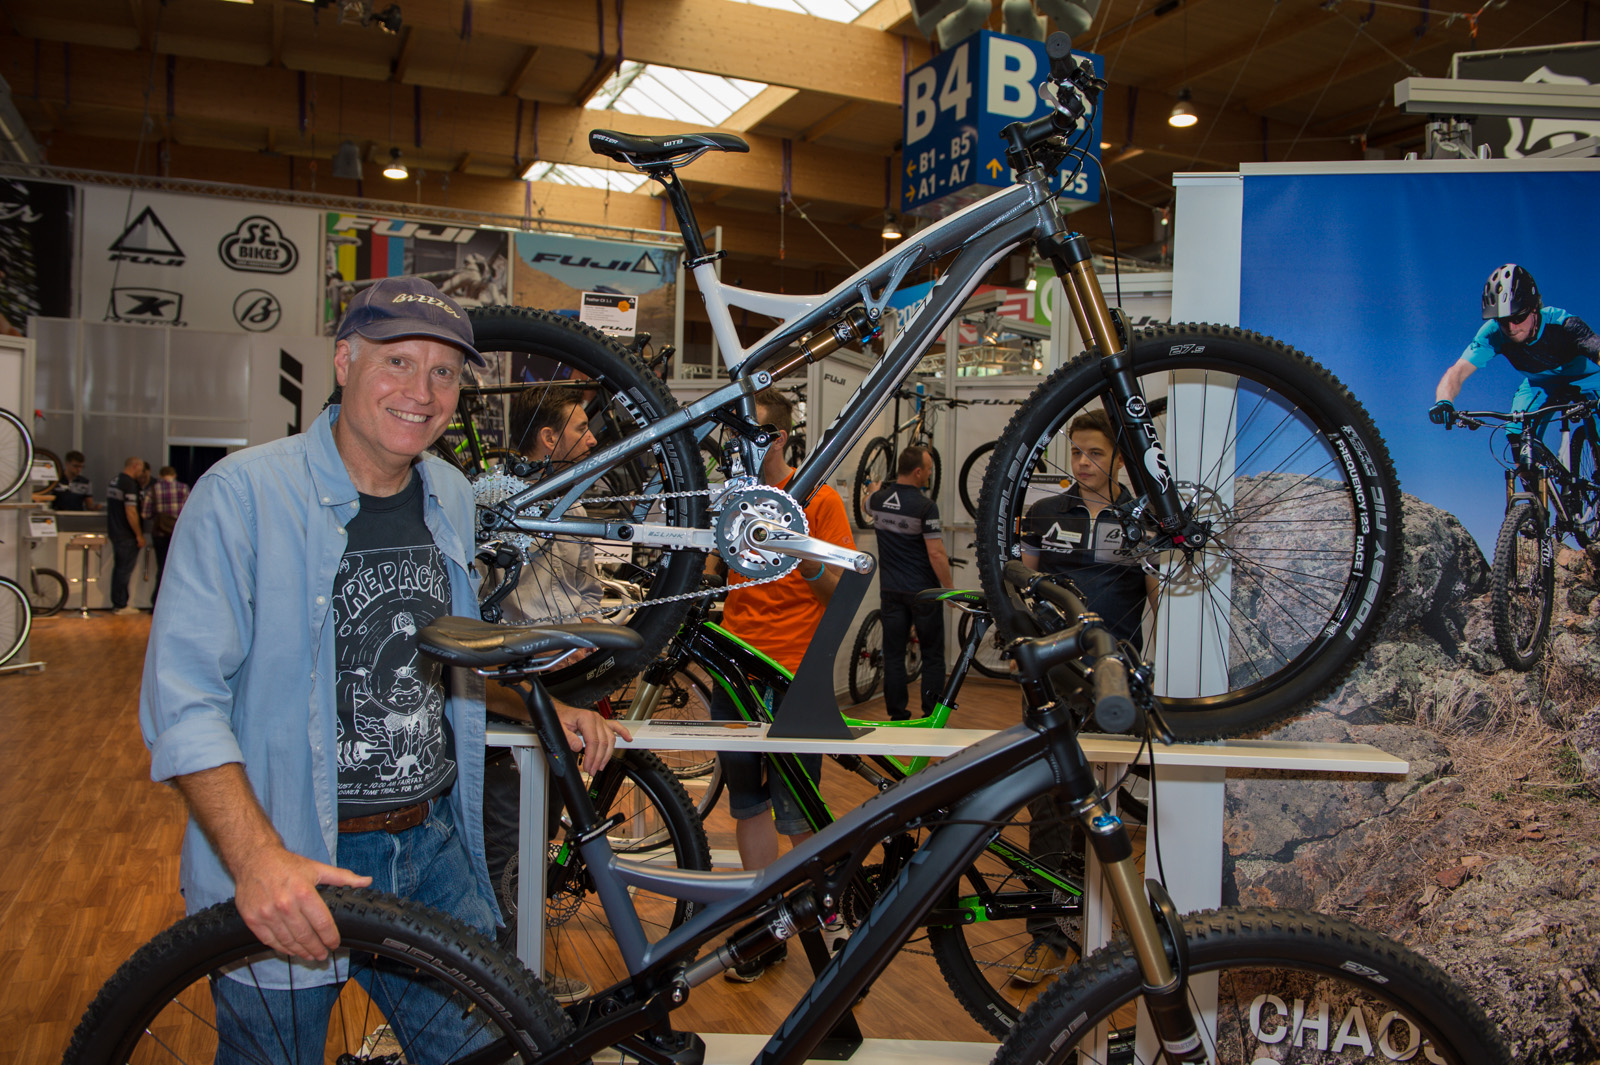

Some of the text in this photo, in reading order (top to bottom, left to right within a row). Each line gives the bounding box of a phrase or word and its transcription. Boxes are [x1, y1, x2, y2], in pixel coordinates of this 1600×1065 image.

[907, 42, 972, 146] B4
[663, 138, 684, 147] WTB
[919, 148, 936, 174] B1
[951, 131, 971, 160] B5
[918, 172, 936, 200] A1
[949, 158, 970, 186] A7
[241, 223, 277, 247] SE
[332, 216, 477, 244] FUJI
[108, 254, 186, 267] FUJI
[238, 246, 279, 261] BIKES
[531, 251, 632, 273] FUJI
[1169, 343, 1206, 356] 27.5
[824, 374, 846, 385] FUJI
[1335, 439, 1367, 512] FREQUENCY
[1354, 535, 1365, 570] RACE
[341, 559, 445, 620] REPACK
[397, 776, 423, 786] FAIRFAX
[1340, 960, 1390, 985] 27.5
